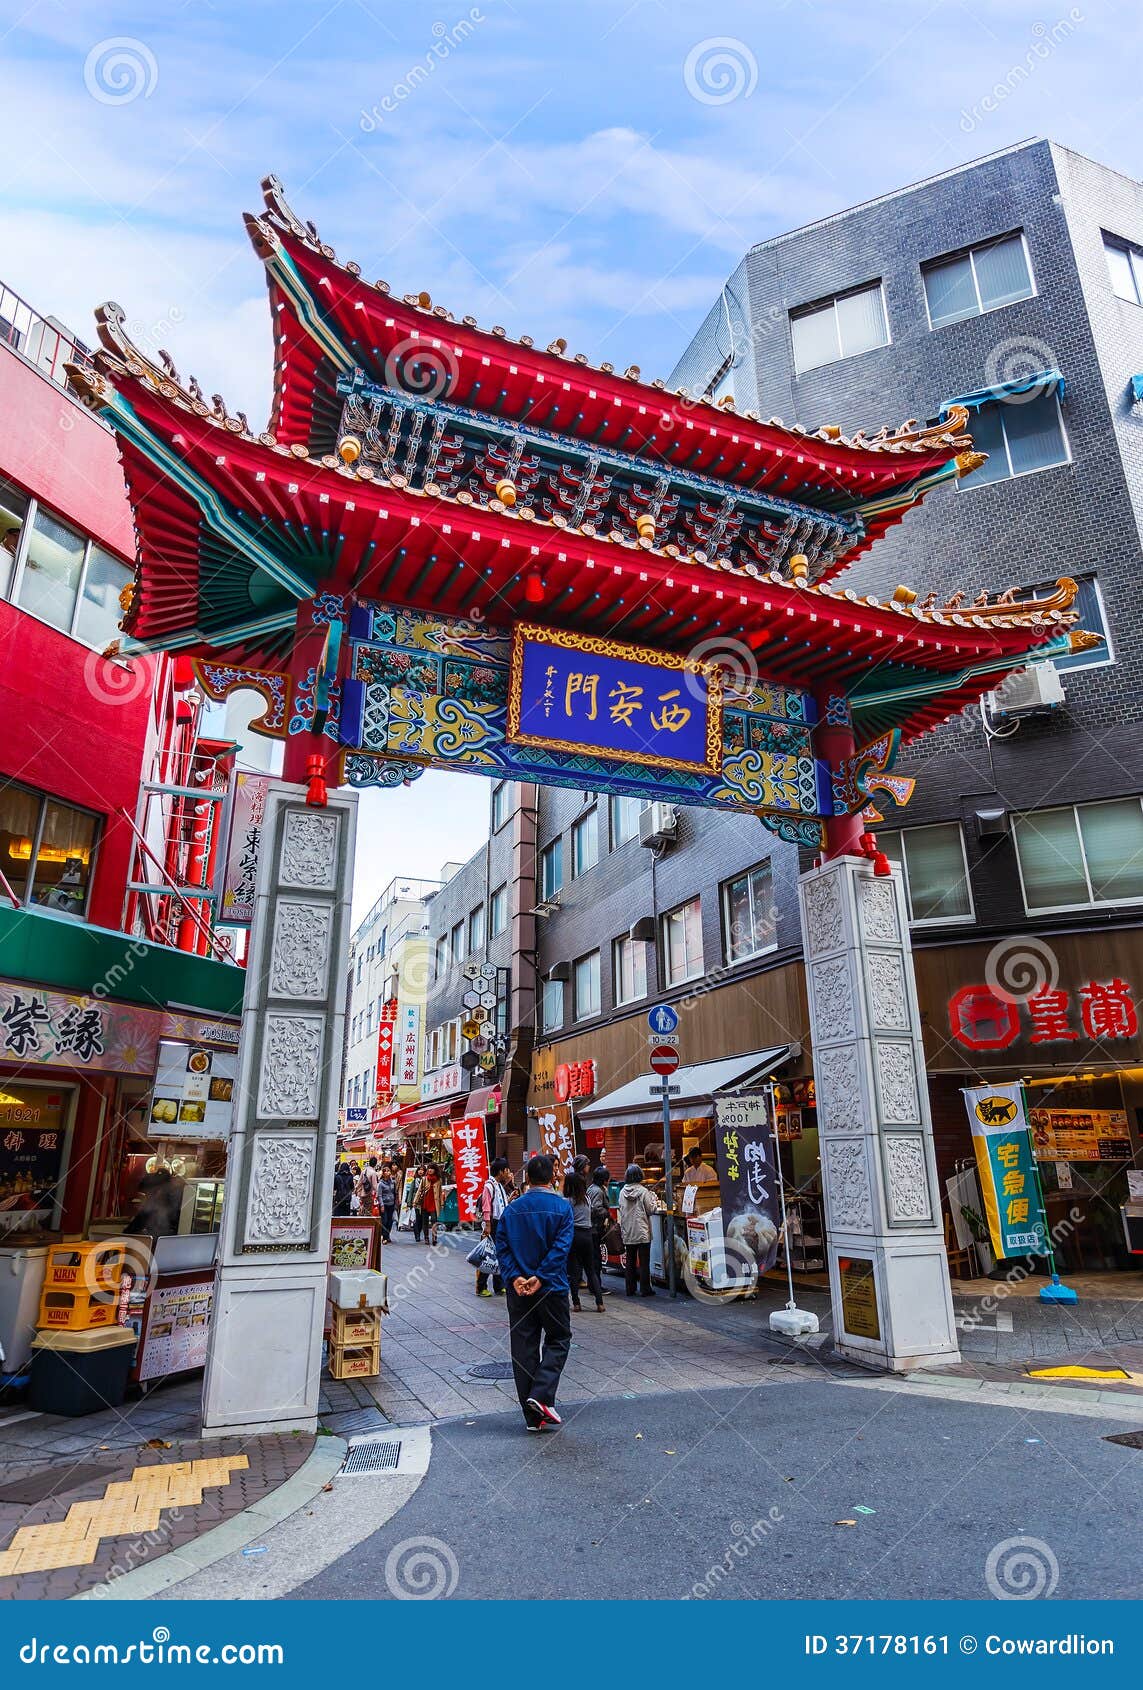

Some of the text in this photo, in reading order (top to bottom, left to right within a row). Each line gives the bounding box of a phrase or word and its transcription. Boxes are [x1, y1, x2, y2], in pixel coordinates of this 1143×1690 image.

[377, 1055, 390, 1087] 香港
[4, 1131, 57, 1151] 料理
[997, 1142, 1029, 1225] 宅急便
[53, 1268, 77, 1279] KIRIN
[48, 1310, 70, 1320] KIRIN
